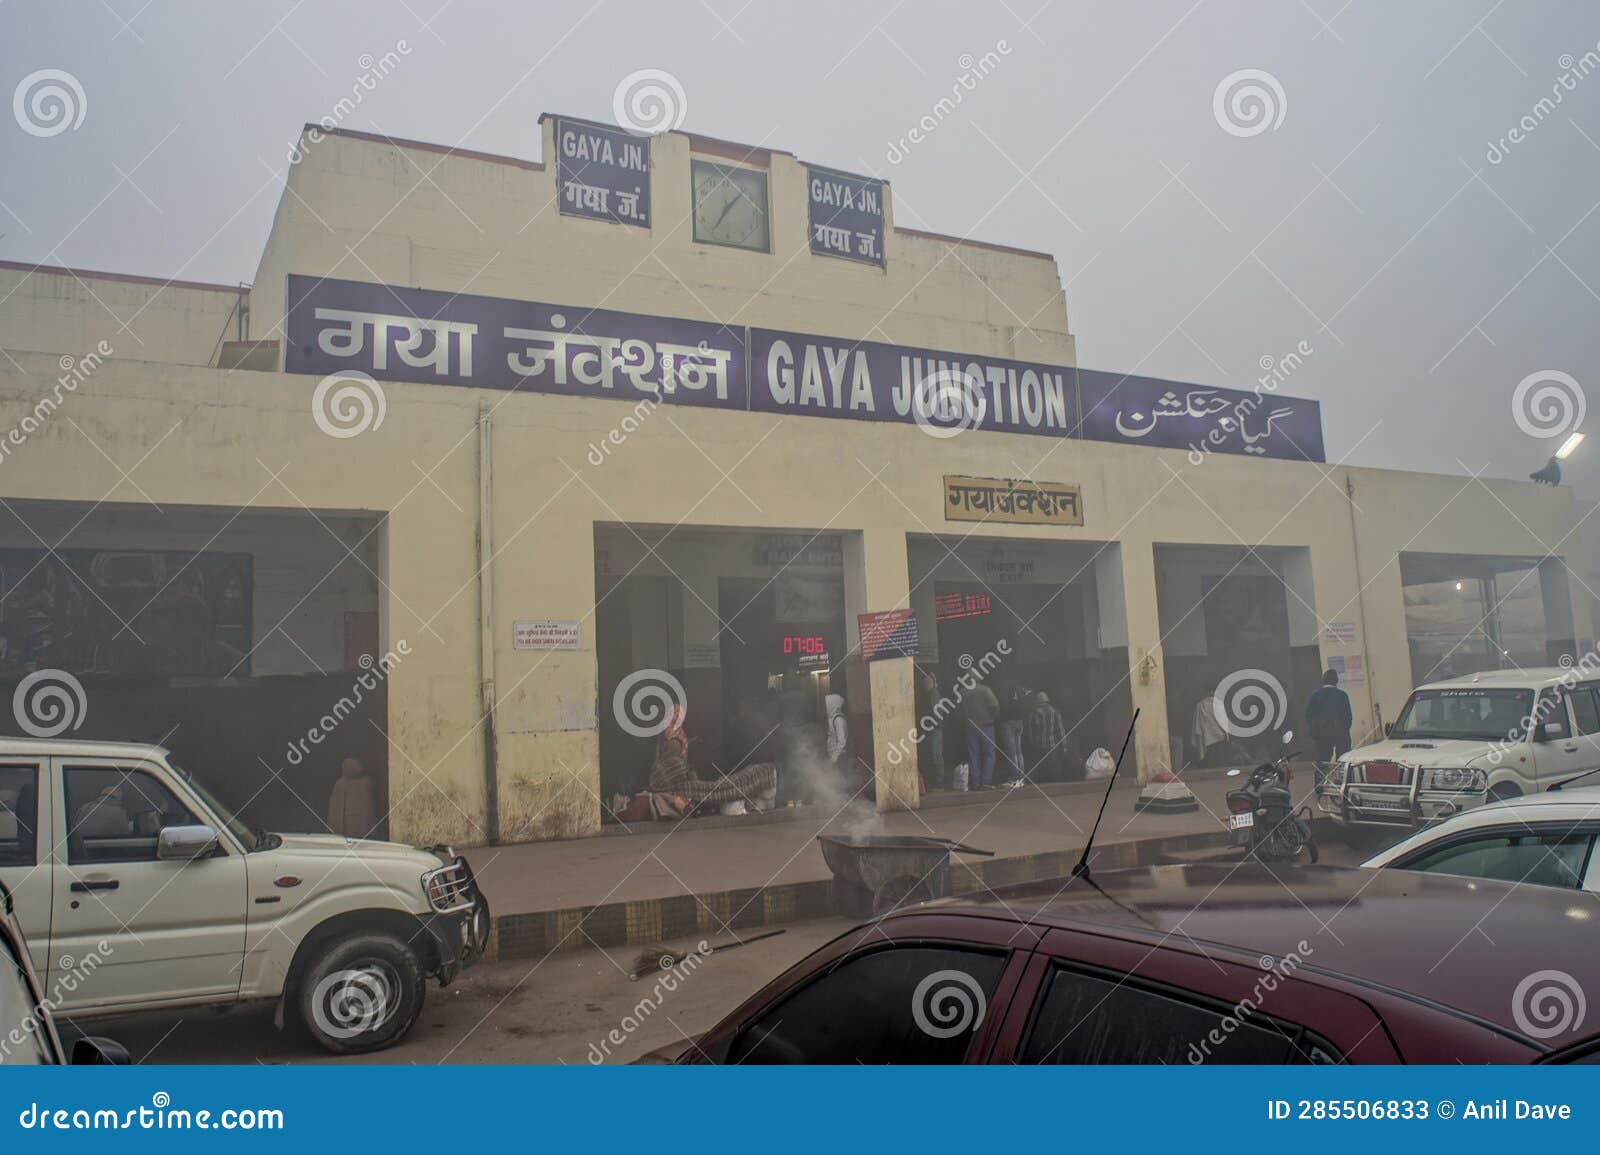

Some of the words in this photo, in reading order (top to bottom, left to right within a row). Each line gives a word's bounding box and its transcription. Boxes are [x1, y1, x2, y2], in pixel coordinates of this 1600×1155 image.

[562, 130, 613, 166] GAYA
[619, 146, 647, 172] JN.
[564, 181, 610, 214] गया
[811, 179, 853, 208] GAYA
[857, 190, 882, 216] JN.
[814, 223, 852, 252] गया
[314, 307, 478, 377] गया
[503, 314, 732, 400] जंक्शन
[767, 339, 875, 412] GAYA
[892, 355, 1067, 428] JUNCTION
